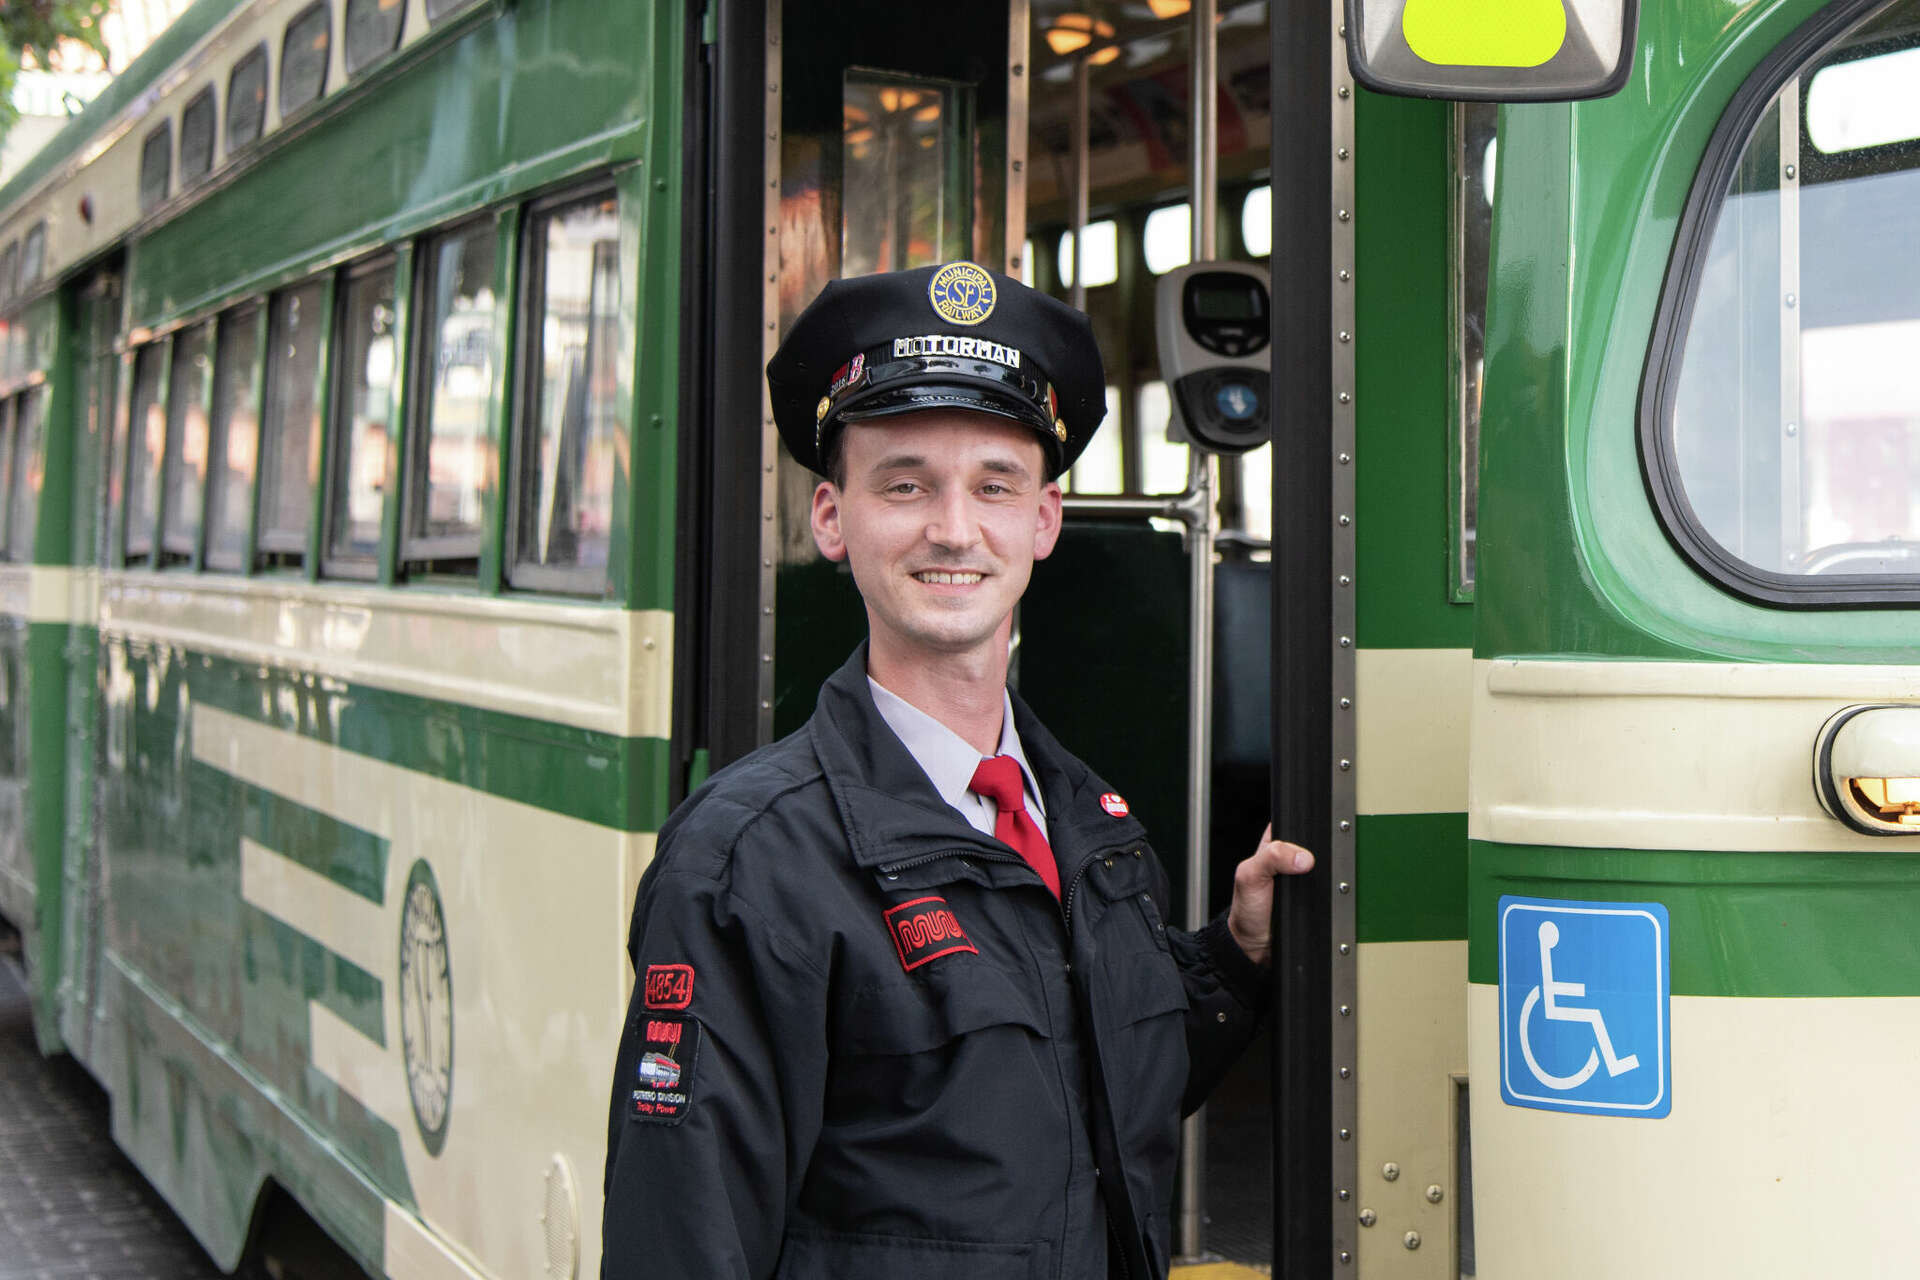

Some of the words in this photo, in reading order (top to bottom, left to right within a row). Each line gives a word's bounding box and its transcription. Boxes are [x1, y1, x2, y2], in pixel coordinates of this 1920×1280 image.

[937, 266, 991, 296] MUNICIPAL
[952, 279, 976, 307] SF
[938, 299, 984, 320] RAILWAY
[893, 334, 1020, 369] MOTORMAN
[647, 972, 686, 1003] 4854
[657, 1092, 686, 1104] DIVISION
